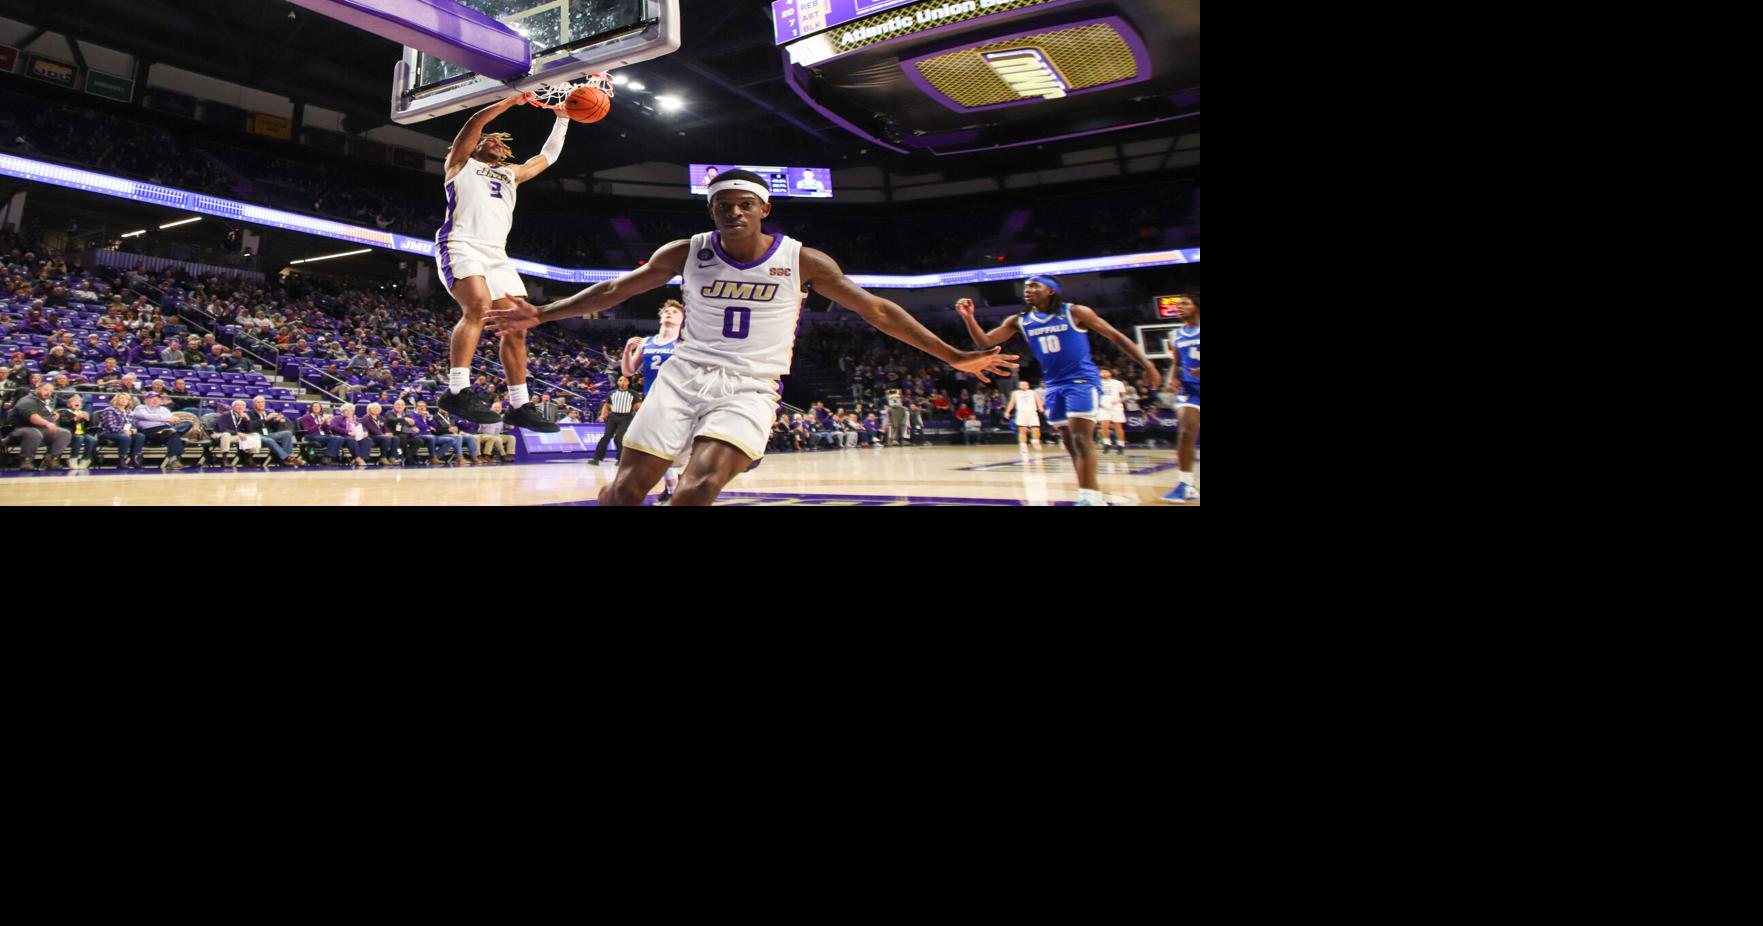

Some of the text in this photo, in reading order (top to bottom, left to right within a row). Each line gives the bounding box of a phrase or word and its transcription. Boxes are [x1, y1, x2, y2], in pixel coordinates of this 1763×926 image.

[840, 15, 914, 47] Atlantic
[915, 0, 977, 25] Union
[792, 28, 798, 37] 1
[400, 240, 433, 253] JMU
[701, 280, 779, 302] JMU
[722, 306, 751, 339] 0
[1027, 323, 1068, 337] BUFFALO
[1038, 335, 1061, 354] 10
[650, 354, 662, 370] 2
